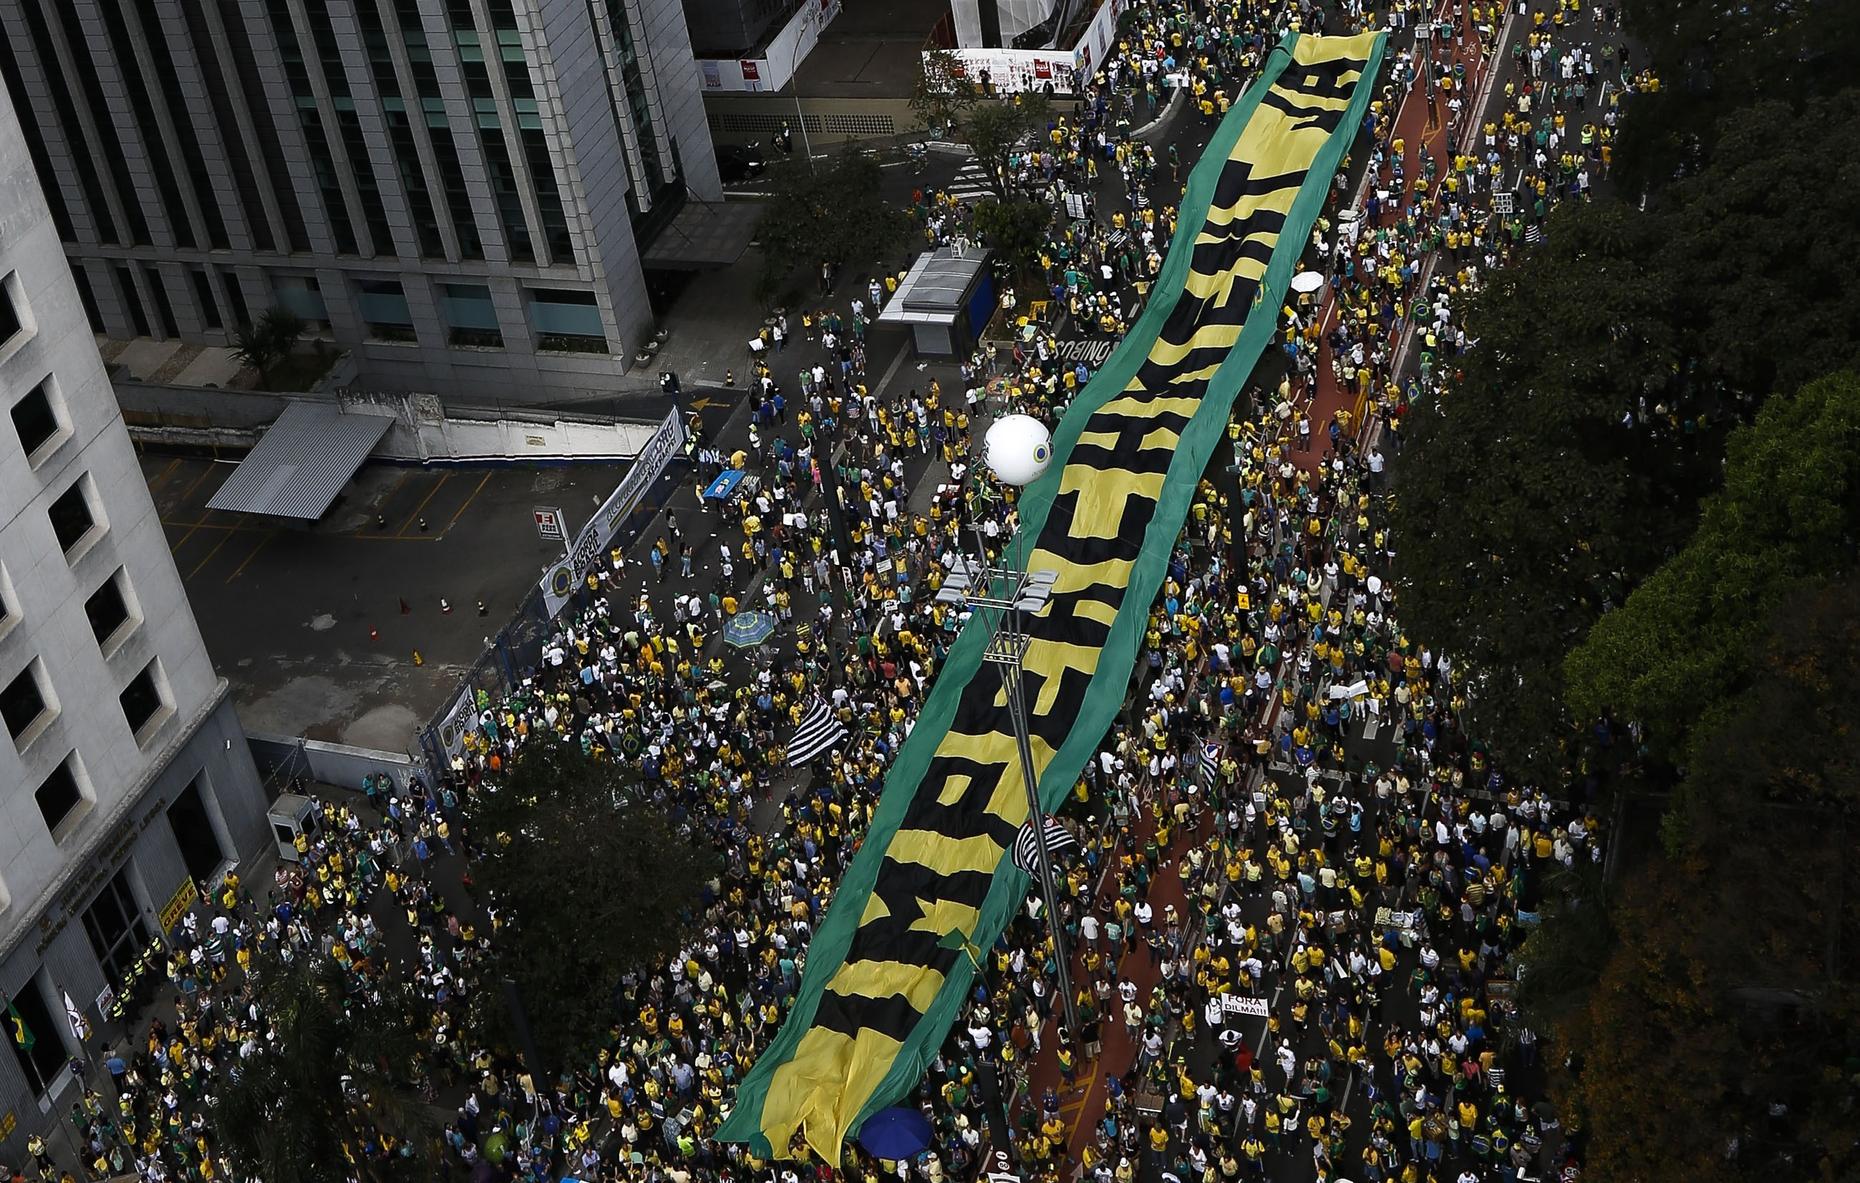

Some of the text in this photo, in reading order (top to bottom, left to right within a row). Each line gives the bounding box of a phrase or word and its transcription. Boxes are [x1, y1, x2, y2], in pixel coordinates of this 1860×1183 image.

[1053, 341, 1110, 367] ÔNIBUS
[573, 529, 598, 570] ACORDA
[575, 538, 602, 579] BRASIL
[810, 160, 1311, 1042] IMPEACHMENT
[1225, 1004, 1267, 1015] DILMA!!!
[1228, 995, 1262, 1007] FORA
